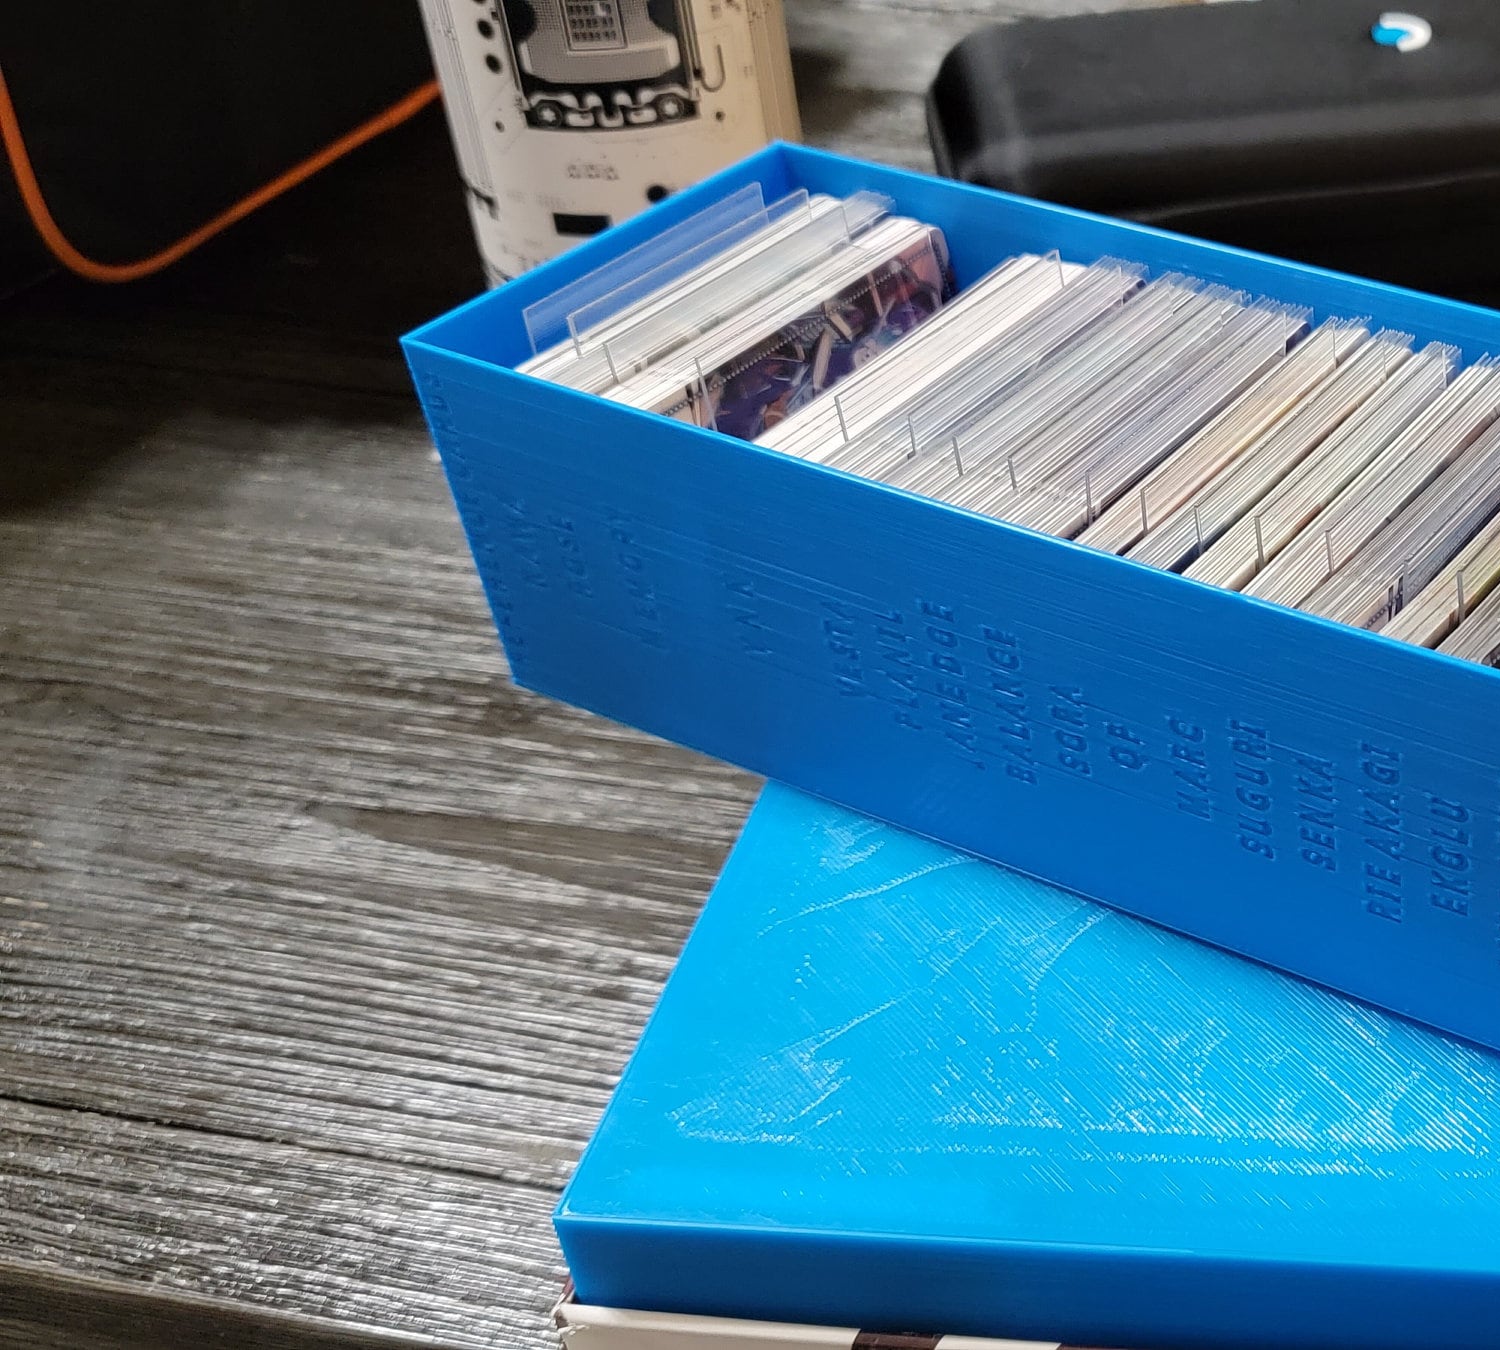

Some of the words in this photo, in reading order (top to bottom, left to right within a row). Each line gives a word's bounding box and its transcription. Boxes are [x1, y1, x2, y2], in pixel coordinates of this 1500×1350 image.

[548, 516, 593, 599] ROSE
[604, 506, 669, 651] MEMORY
[819, 600, 869, 699] VESTA
[872, 609, 922, 731] PLANIL
[918, 598, 965, 677] DOE
[980, 624, 1038, 785] BALANCE
[1047, 683, 1092, 776] SORA
[1105, 720, 1148, 771] QP
[1166, 715, 1211, 821] MARC
[1227, 718, 1276, 861] SUGURI
[1293, 755, 1337, 872] SENKA
[1356, 740, 1403, 861] AKAGI
[1362, 863, 1403, 924] RIE
[1423, 791, 1470, 917] EKOLU
